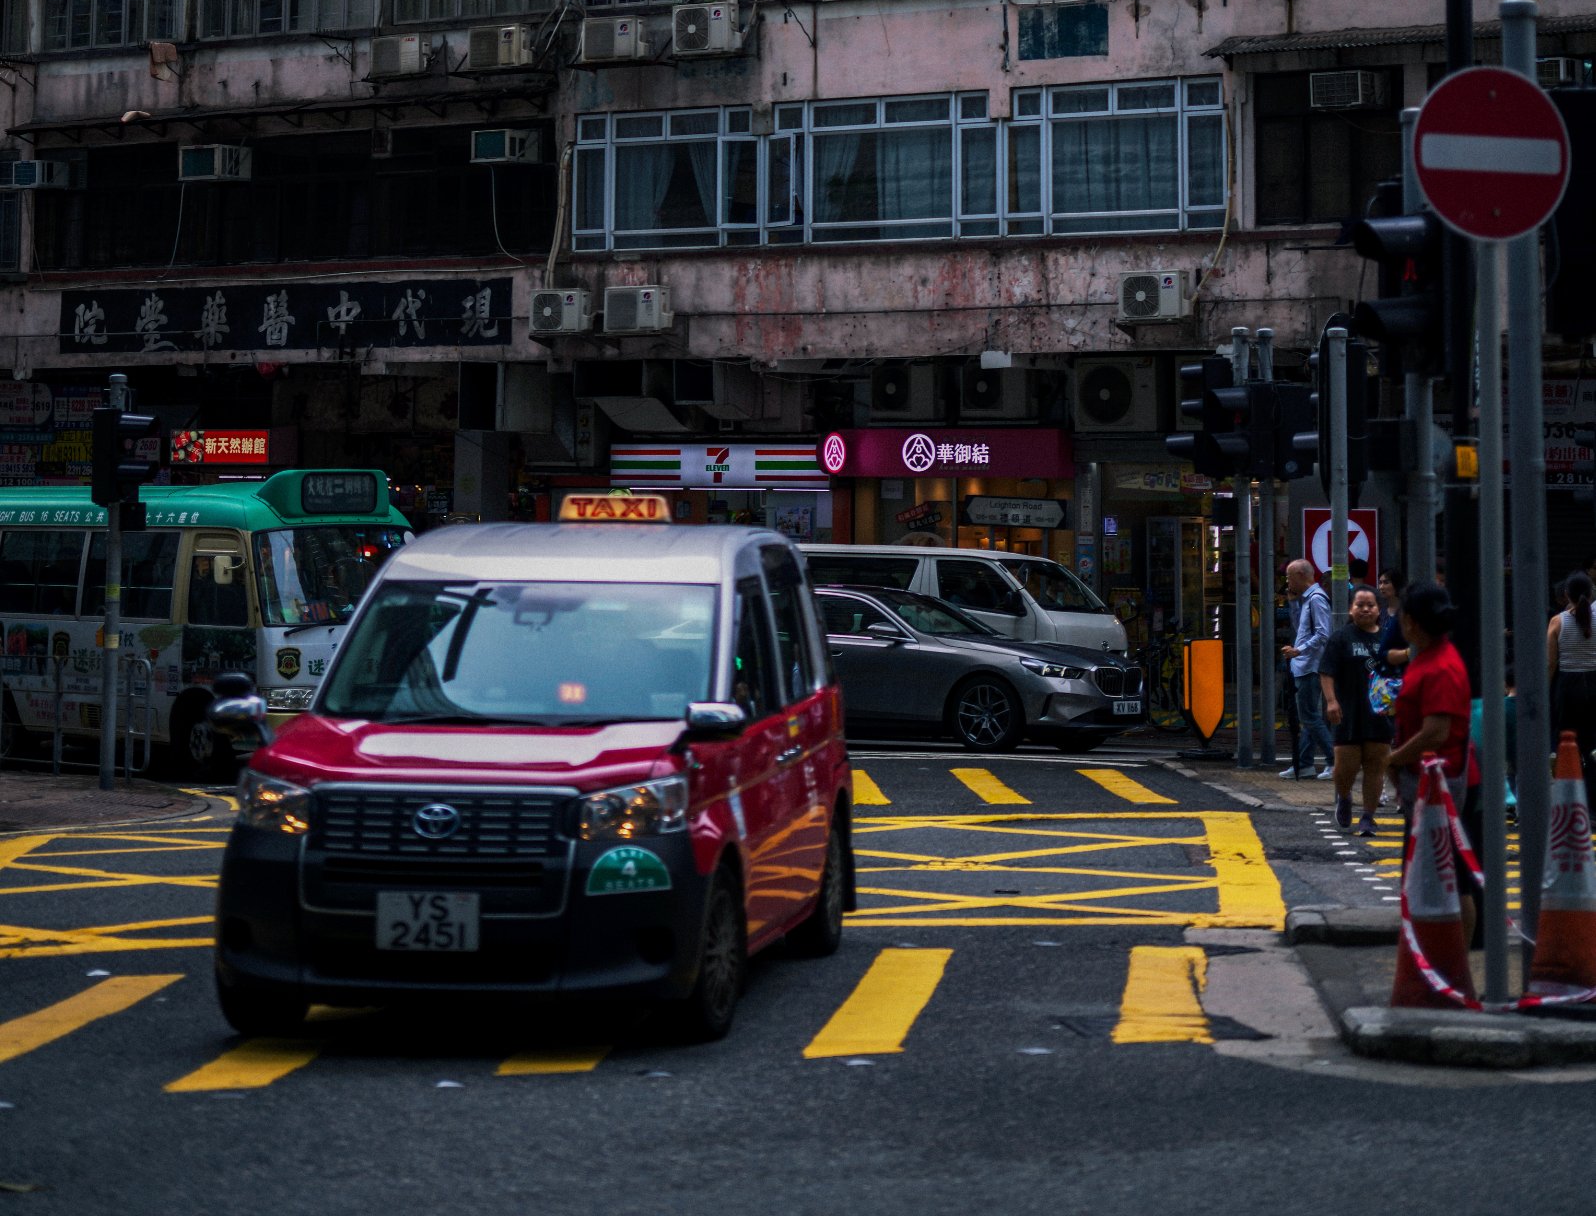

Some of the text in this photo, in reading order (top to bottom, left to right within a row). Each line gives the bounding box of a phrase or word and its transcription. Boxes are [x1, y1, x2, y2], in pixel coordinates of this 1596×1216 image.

[205, 437, 266, 455] 新天然辦館
[936, 443, 990, 464] 華御結
[570, 497, 658, 520] TAXI
[1022, 501, 1043, 510] Road
[19, 511, 36, 522] BUS
[40, 511, 49, 522] 16
[53, 511, 81, 522] SEATS
[621, 860, 637, 877] 4
[408, 894, 449, 921] YS
[390, 921, 466, 948] 2451
